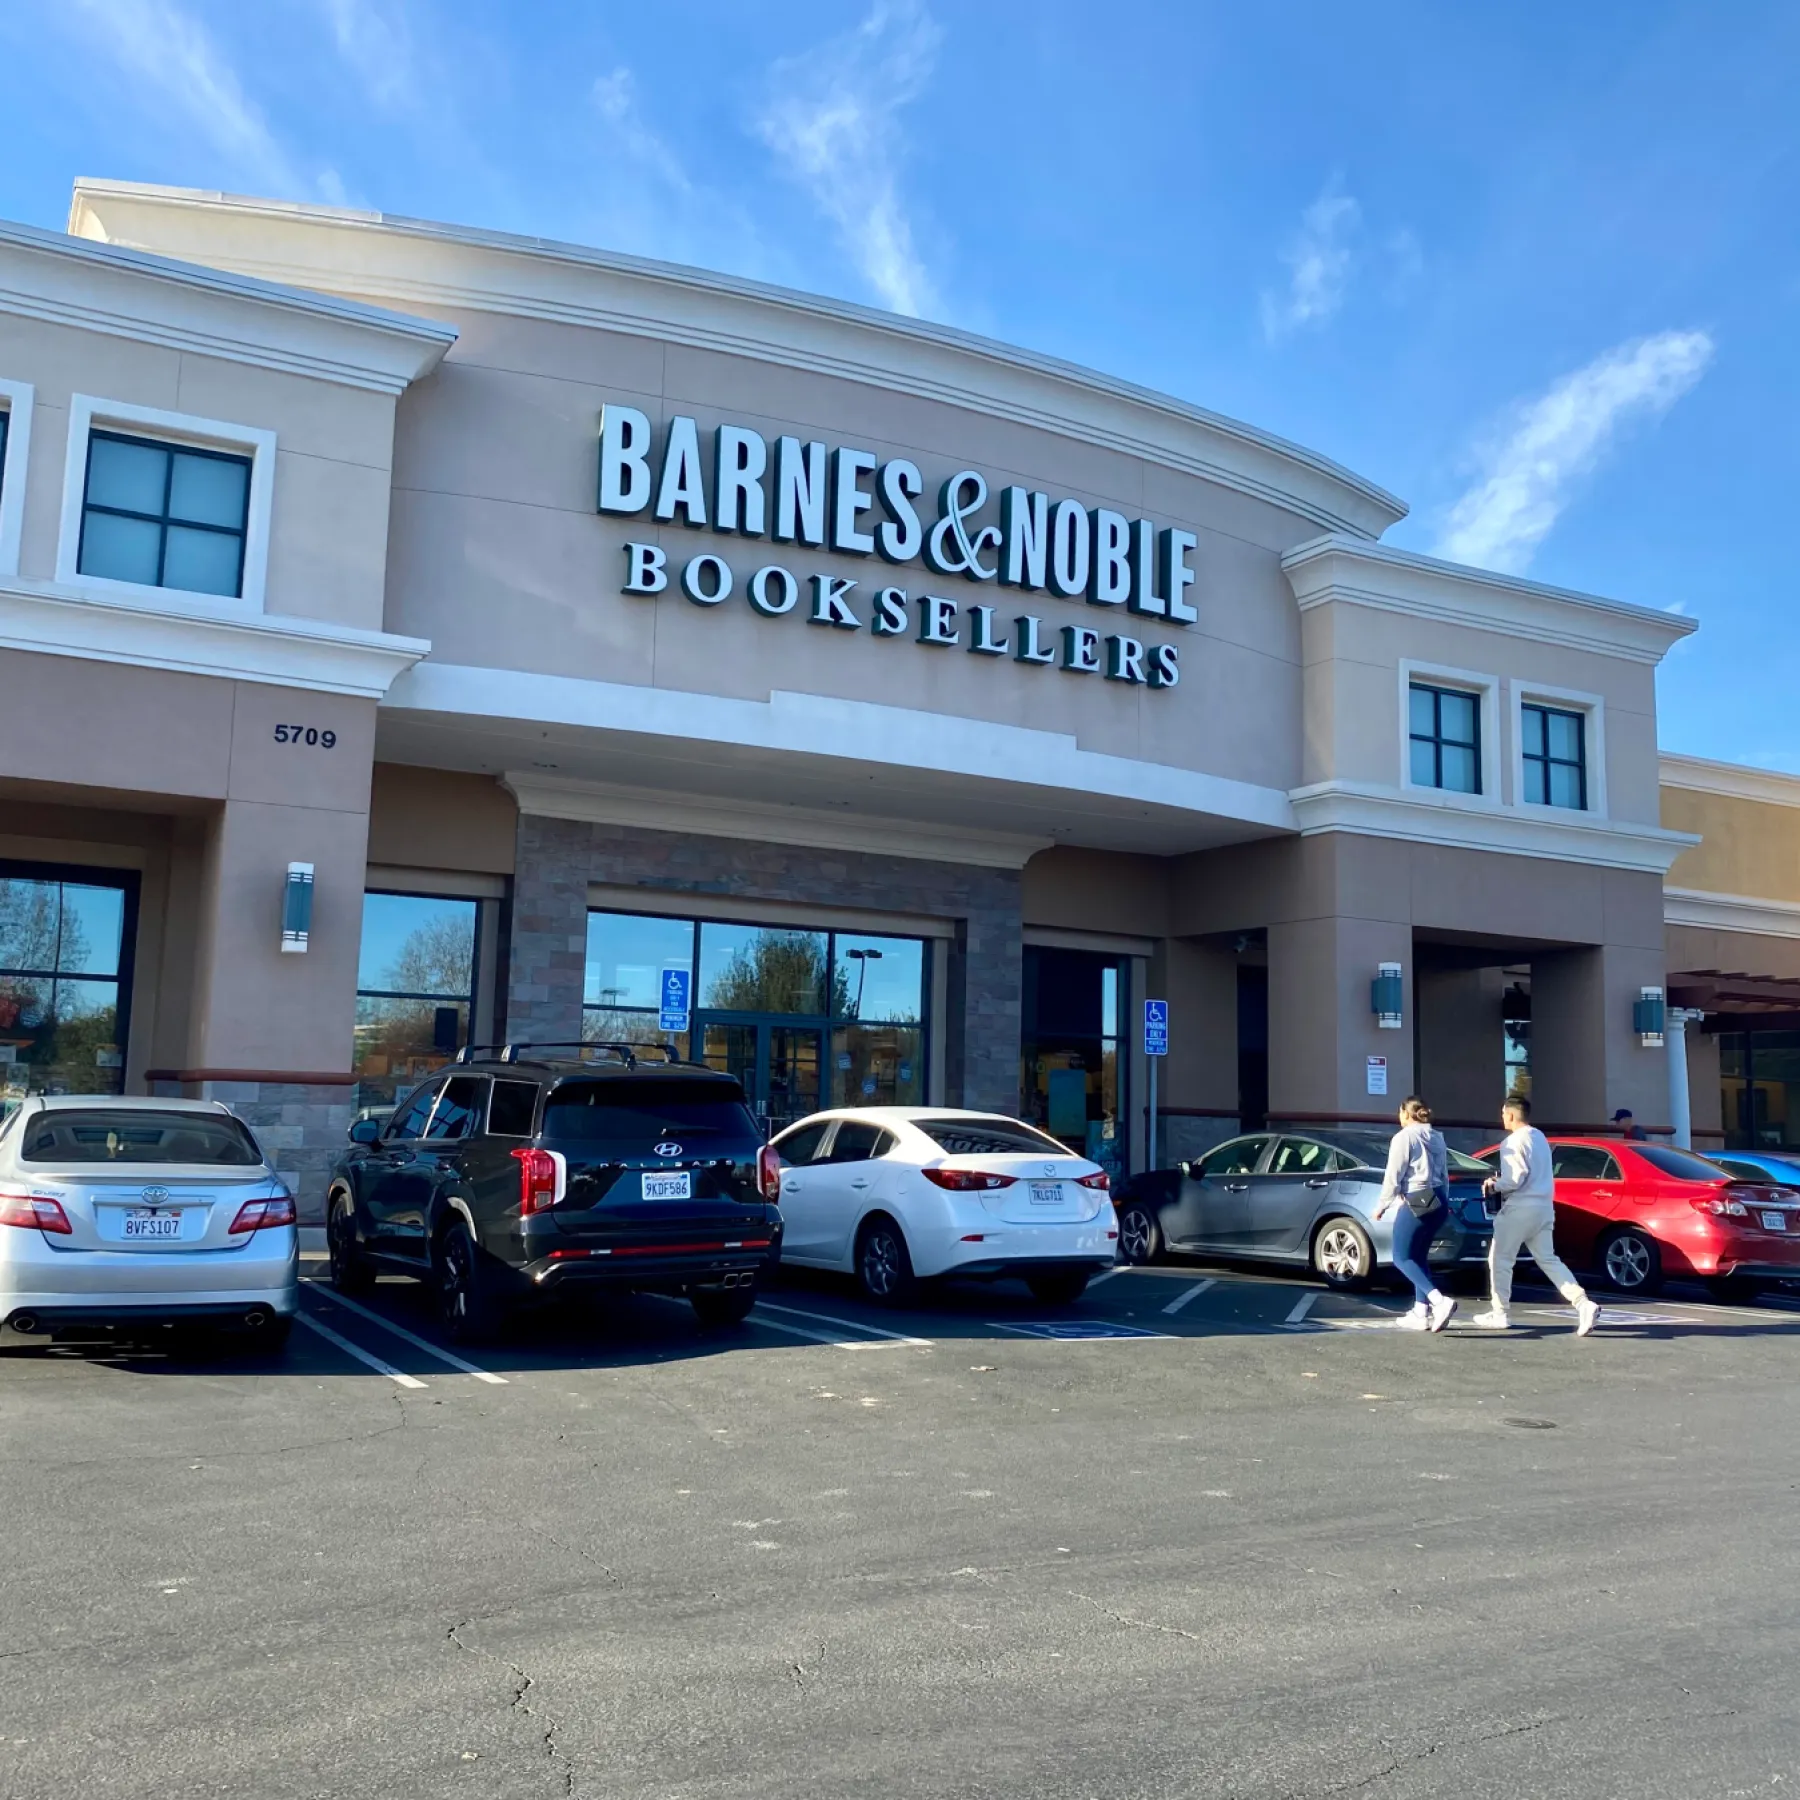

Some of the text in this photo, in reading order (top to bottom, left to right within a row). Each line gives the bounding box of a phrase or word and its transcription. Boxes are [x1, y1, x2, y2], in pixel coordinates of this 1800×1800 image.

[620, 542, 1181, 690] BOOKSELLERS
[273, 723, 337, 749] 5709
[645, 1181, 688, 1196] 9KDF586
[126, 1220, 179, 1234] 8VFS107
